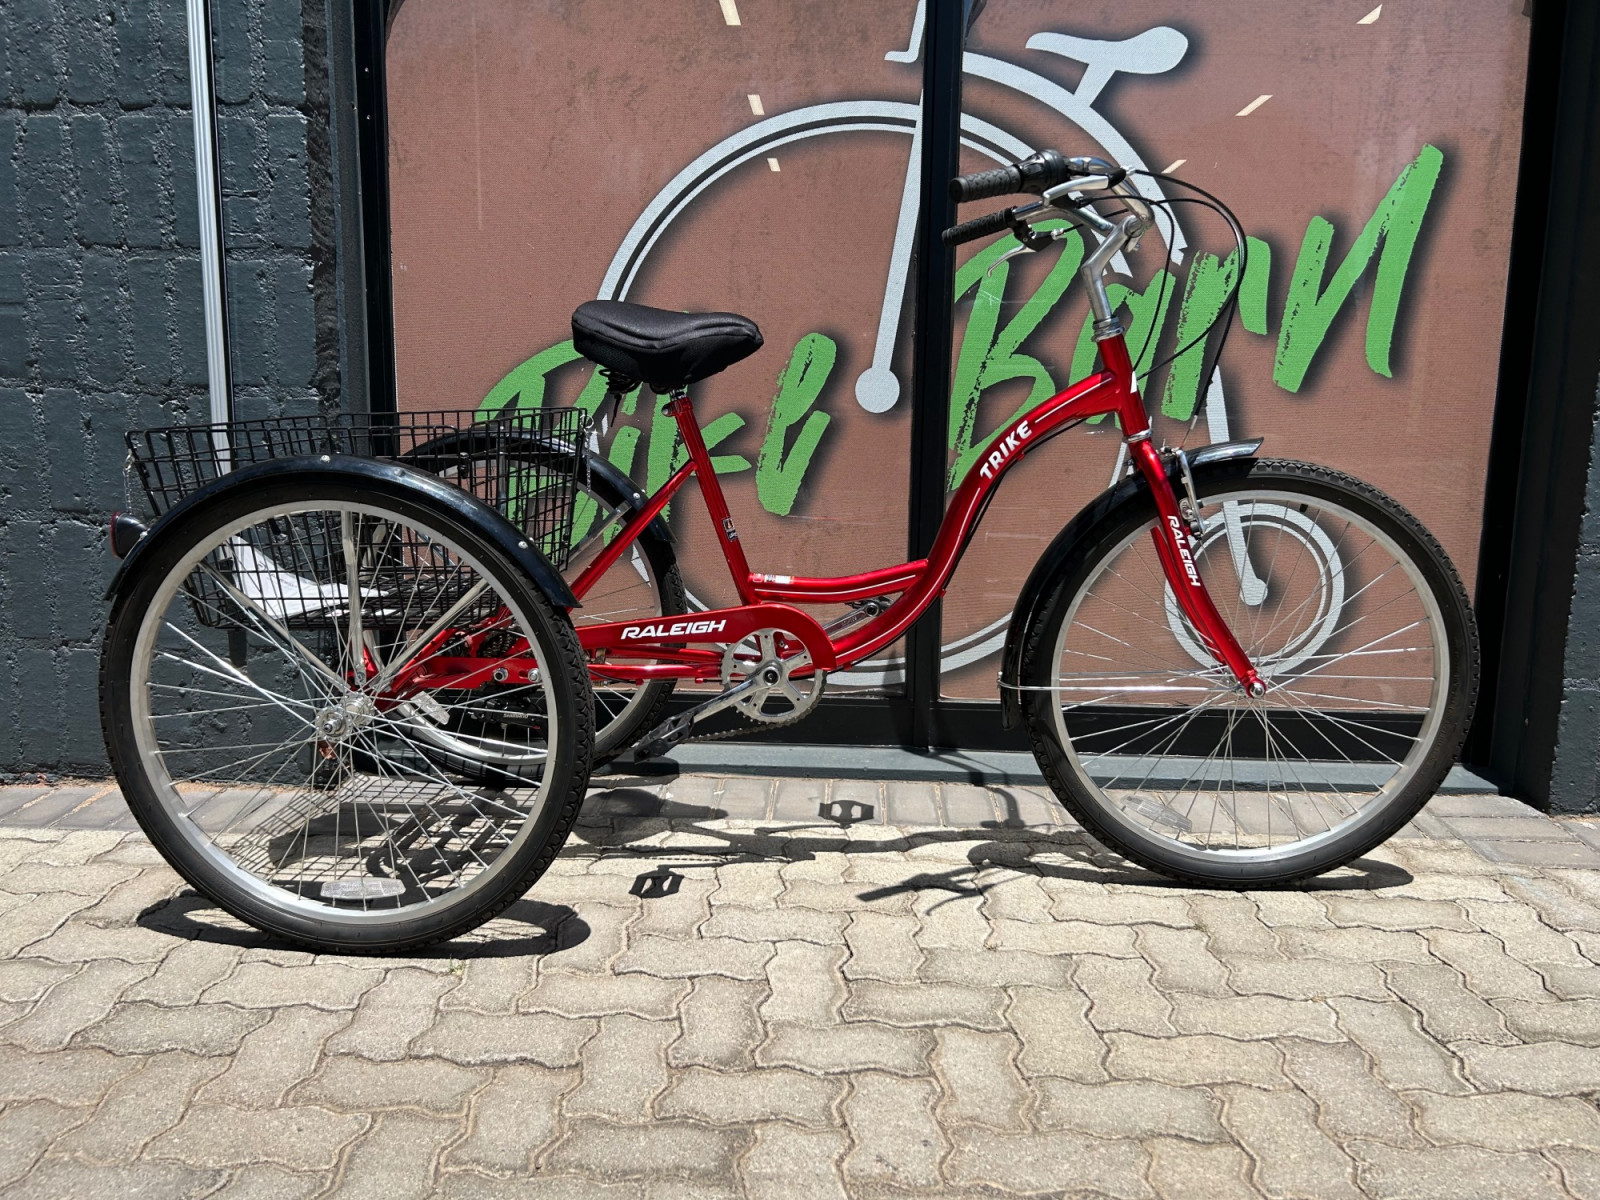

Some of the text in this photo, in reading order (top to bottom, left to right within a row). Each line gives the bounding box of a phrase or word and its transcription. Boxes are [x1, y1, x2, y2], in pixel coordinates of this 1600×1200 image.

[979, 420, 1033, 480] TRIKE
[1167, 515, 1201, 587] RALEIGH
[620, 619, 727, 640] RALEIGH
